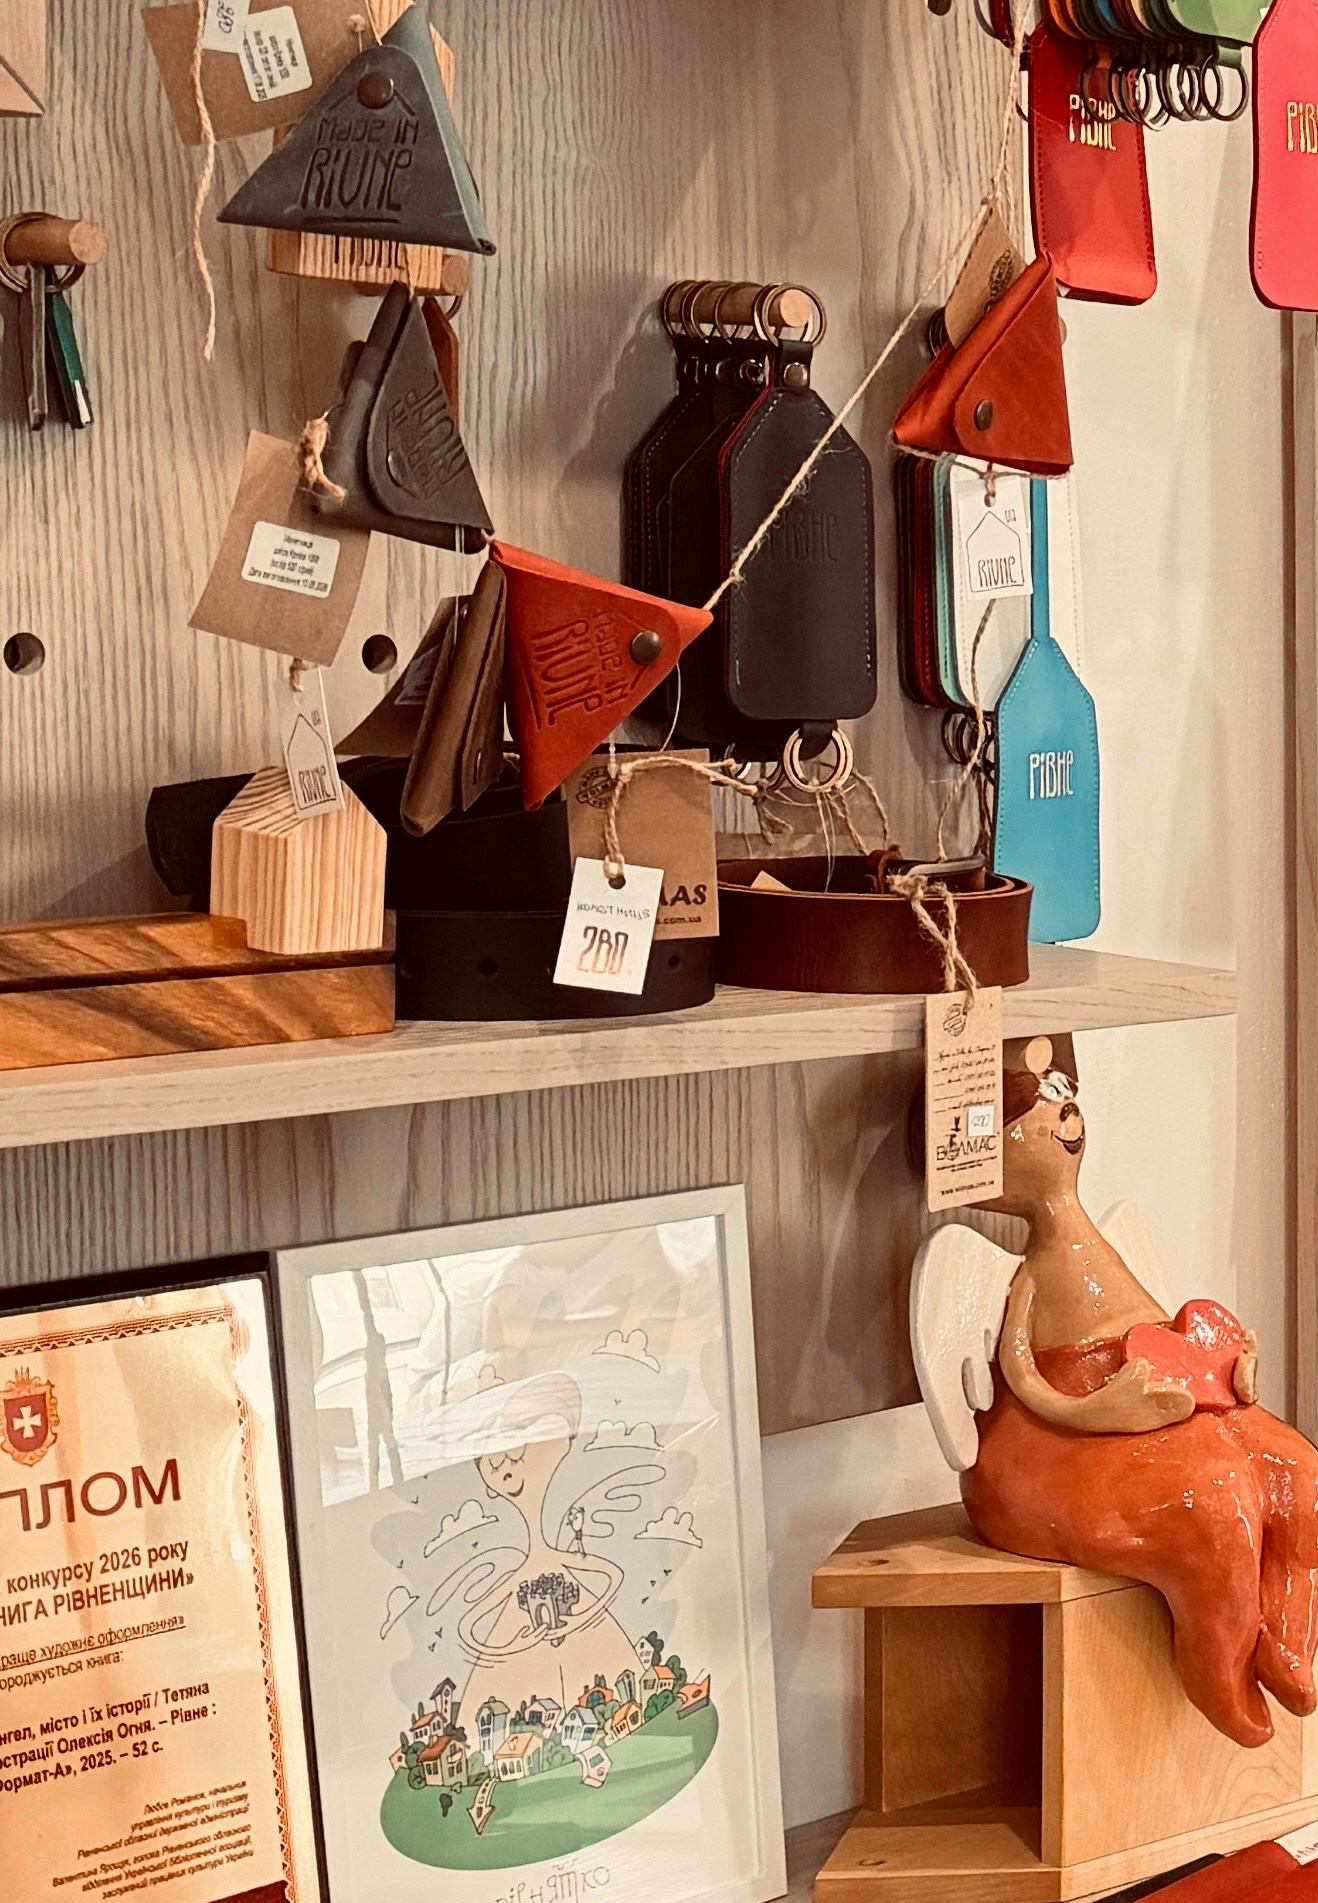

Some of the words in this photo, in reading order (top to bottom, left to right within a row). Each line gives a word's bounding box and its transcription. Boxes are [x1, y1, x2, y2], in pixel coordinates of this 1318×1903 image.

[977, 555, 1018, 588] RIVNE
[1028, 751, 1074, 801] РІВНЕ
[576, 925, 629, 975] 280
[7, 1560, 94, 1594] конкурсу
[99, 1546, 142, 1575] 2026
[147, 1540, 189, 1568] року
[53, 1566, 194, 1616] РІВНЕНЩИНИ»
[40, 1633, 96, 1660] художнє
[39, 1712, 79, 1737] місто
[90, 1705, 104, 1723] їх
[106, 1692, 151, 1721] історії
[161, 1681, 210, 1704] Тетяна
[57, 1727, 114, 1755] Олексія
[117, 1721, 156, 1740] Огня.
[170, 1704, 209, 1726] Рівне
[80, 1749, 118, 1773] 2025.
[132, 1739, 149, 1759] 52
